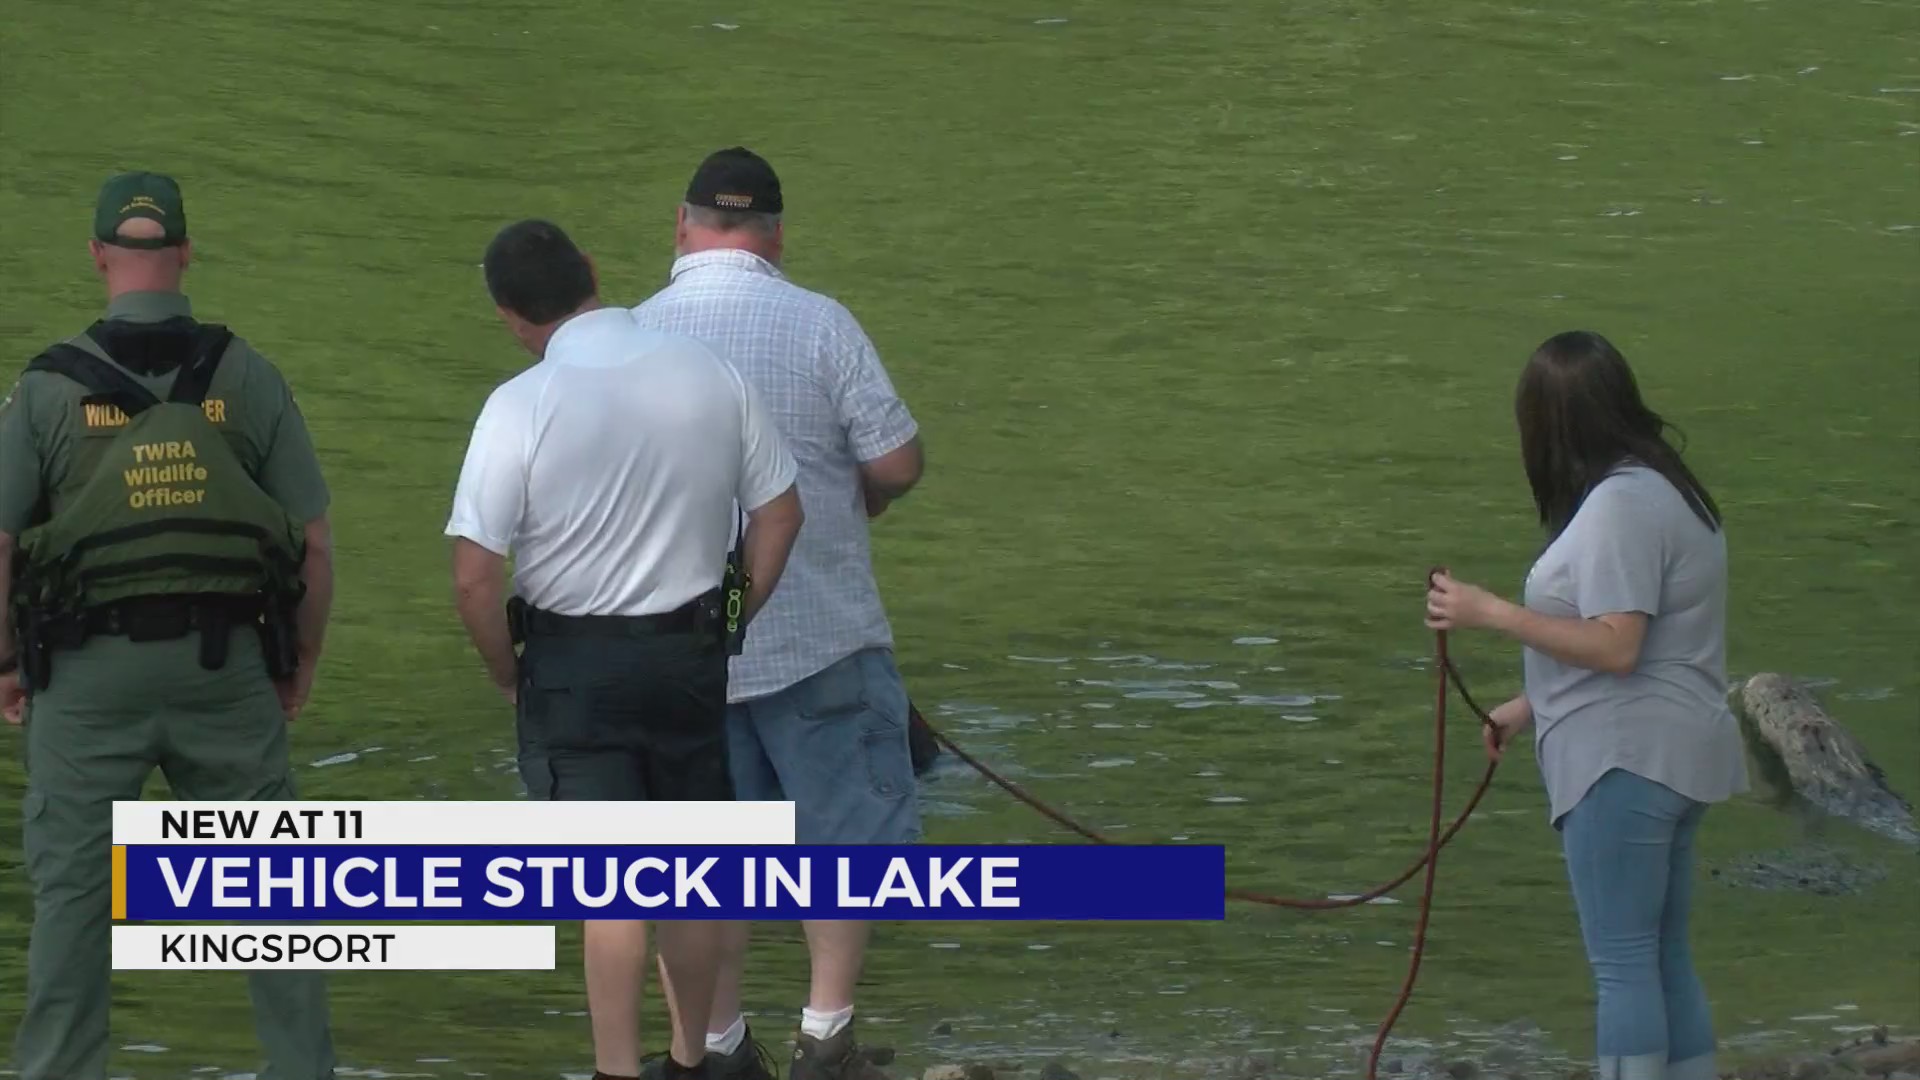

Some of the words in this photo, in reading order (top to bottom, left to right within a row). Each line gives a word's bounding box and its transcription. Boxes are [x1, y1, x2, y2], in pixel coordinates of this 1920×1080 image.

[132, 440, 196, 463] TWRA
[124, 463, 208, 487] Wildlife
[129, 487, 205, 508] Officer
